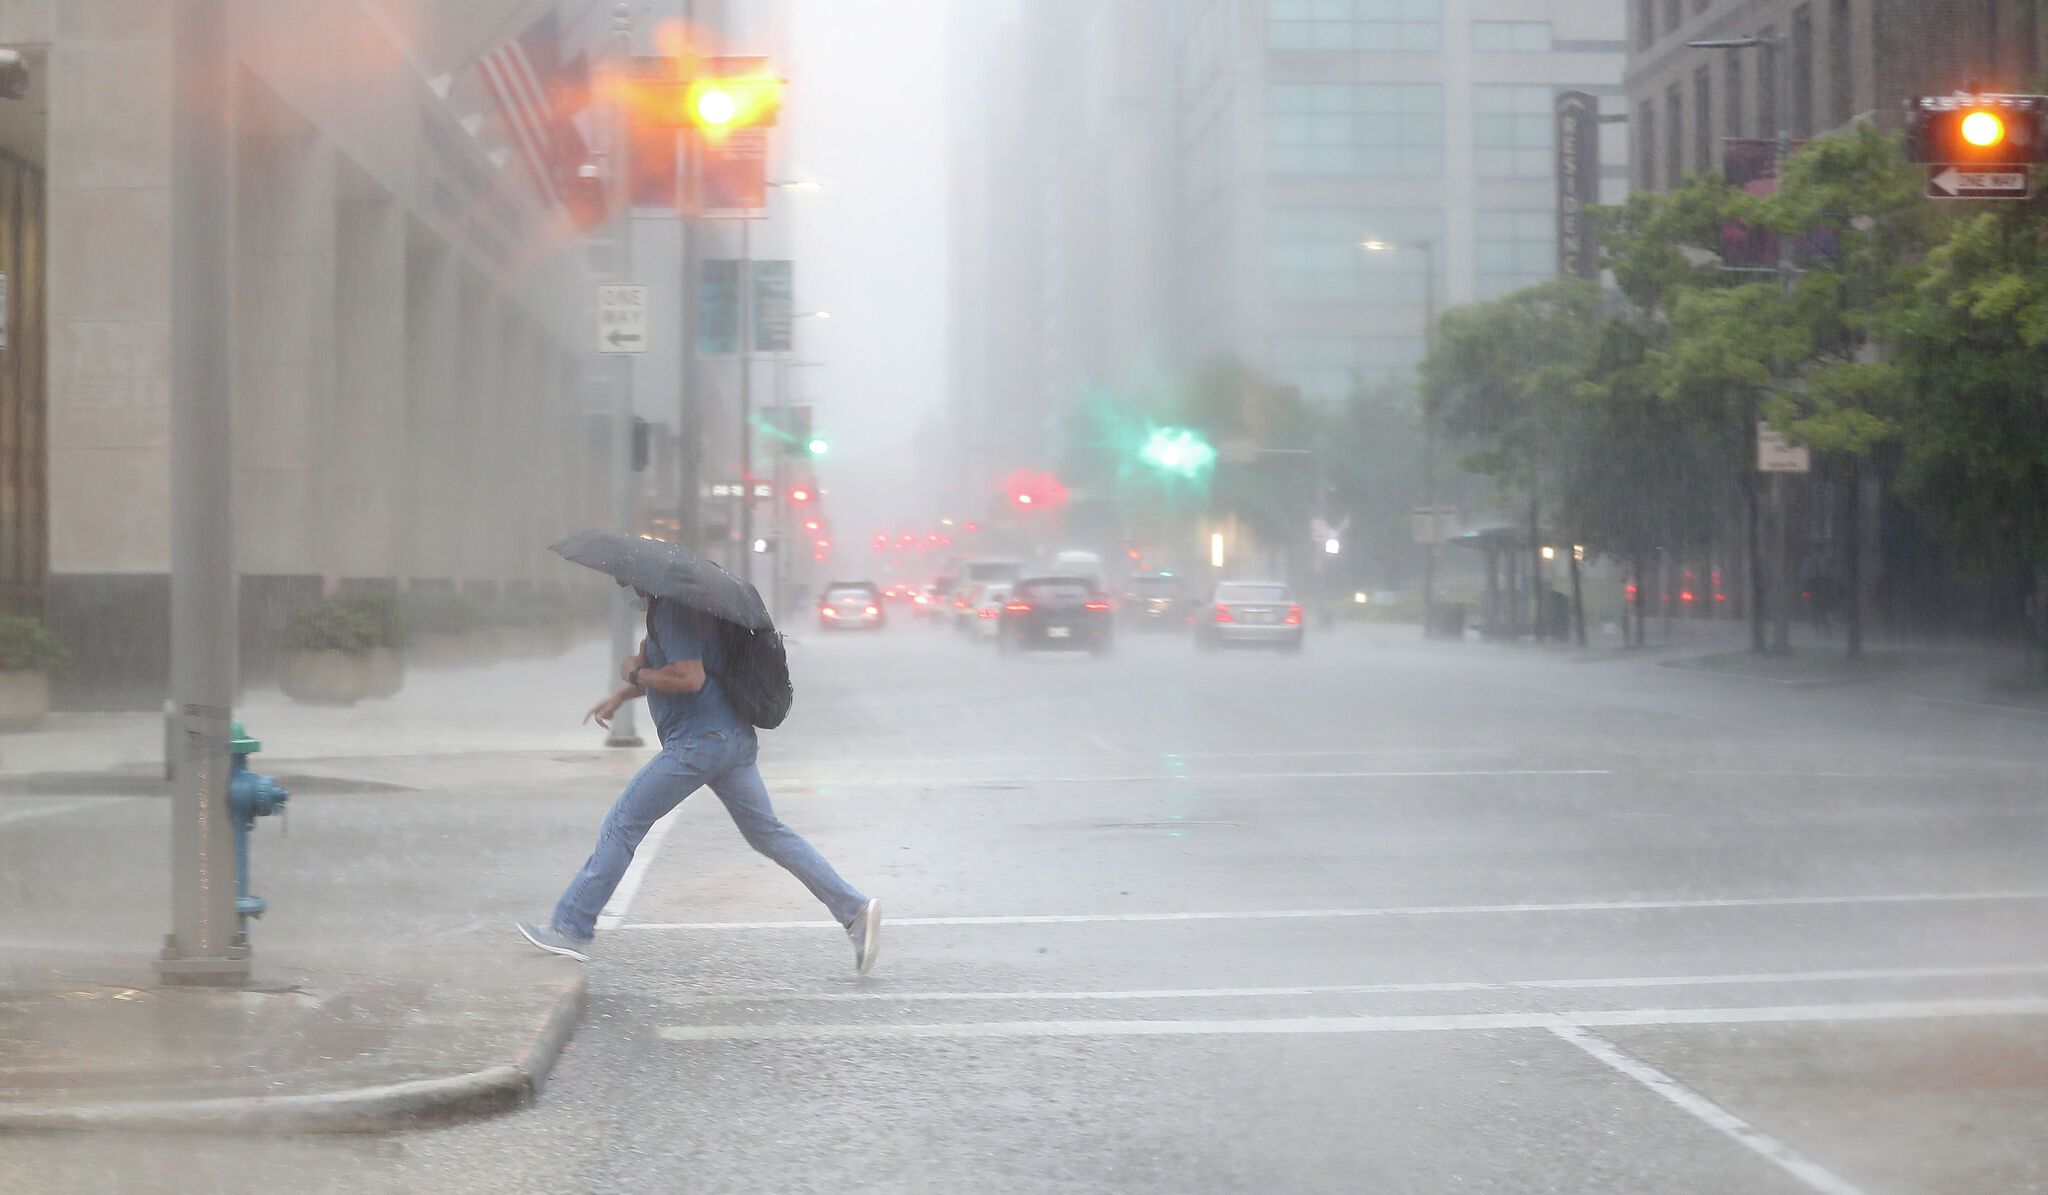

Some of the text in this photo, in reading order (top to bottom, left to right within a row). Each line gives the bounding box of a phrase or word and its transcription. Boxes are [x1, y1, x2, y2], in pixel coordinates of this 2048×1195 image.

[1959, 174, 2018, 188] ONE WAY
[604, 290, 642, 306] ONE
[603, 310, 641, 326] WAY
